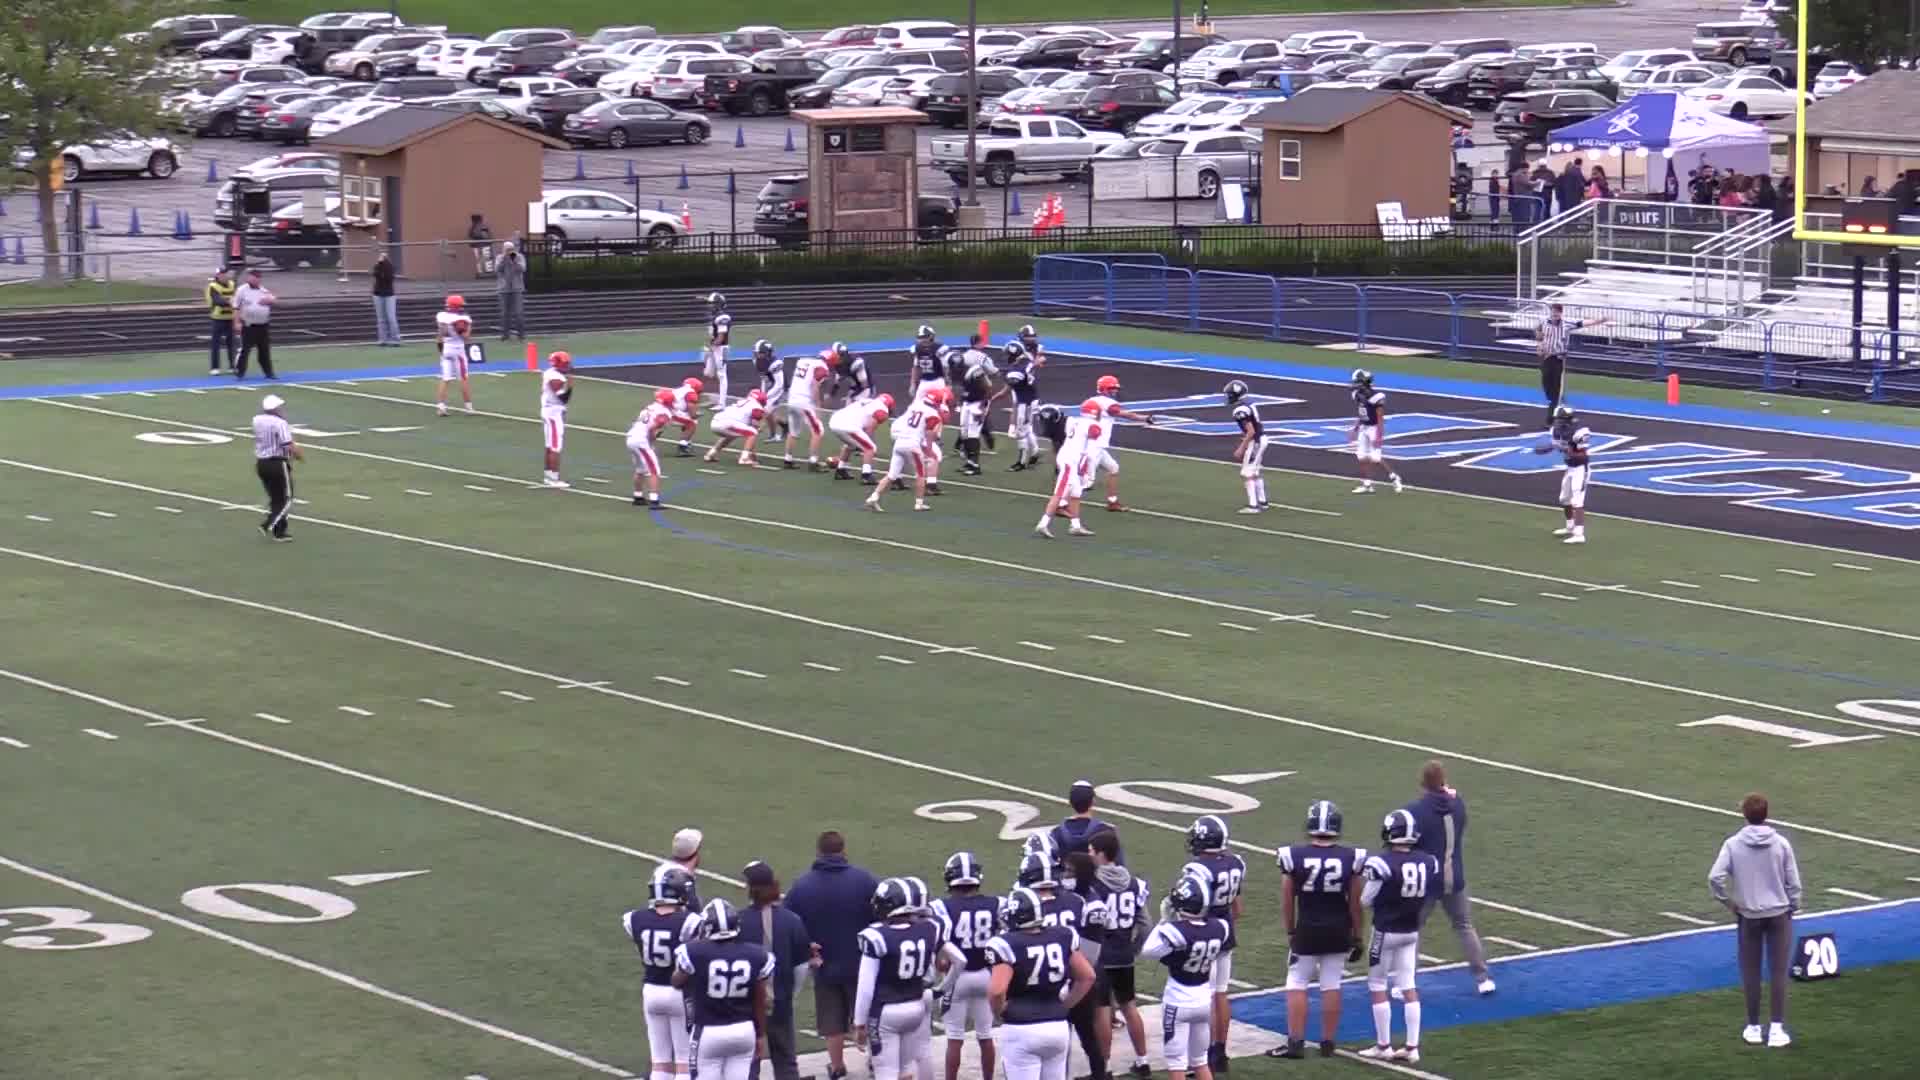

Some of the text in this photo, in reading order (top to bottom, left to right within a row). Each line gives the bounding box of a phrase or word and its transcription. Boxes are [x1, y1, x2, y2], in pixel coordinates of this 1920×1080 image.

[1213, 868, 1243, 906] 28
[1302, 857, 1343, 893] 72
[1401, 862, 1427, 898] 81
[954, 910, 993, 949] 48
[1105, 892, 1136, 929] 49
[641, 929, 672, 968] 15
[898, 938, 926, 980] 61
[1026, 943, 1065, 985] 79
[1804, 936, 1838, 976] 20
[707, 959, 751, 999] 62
